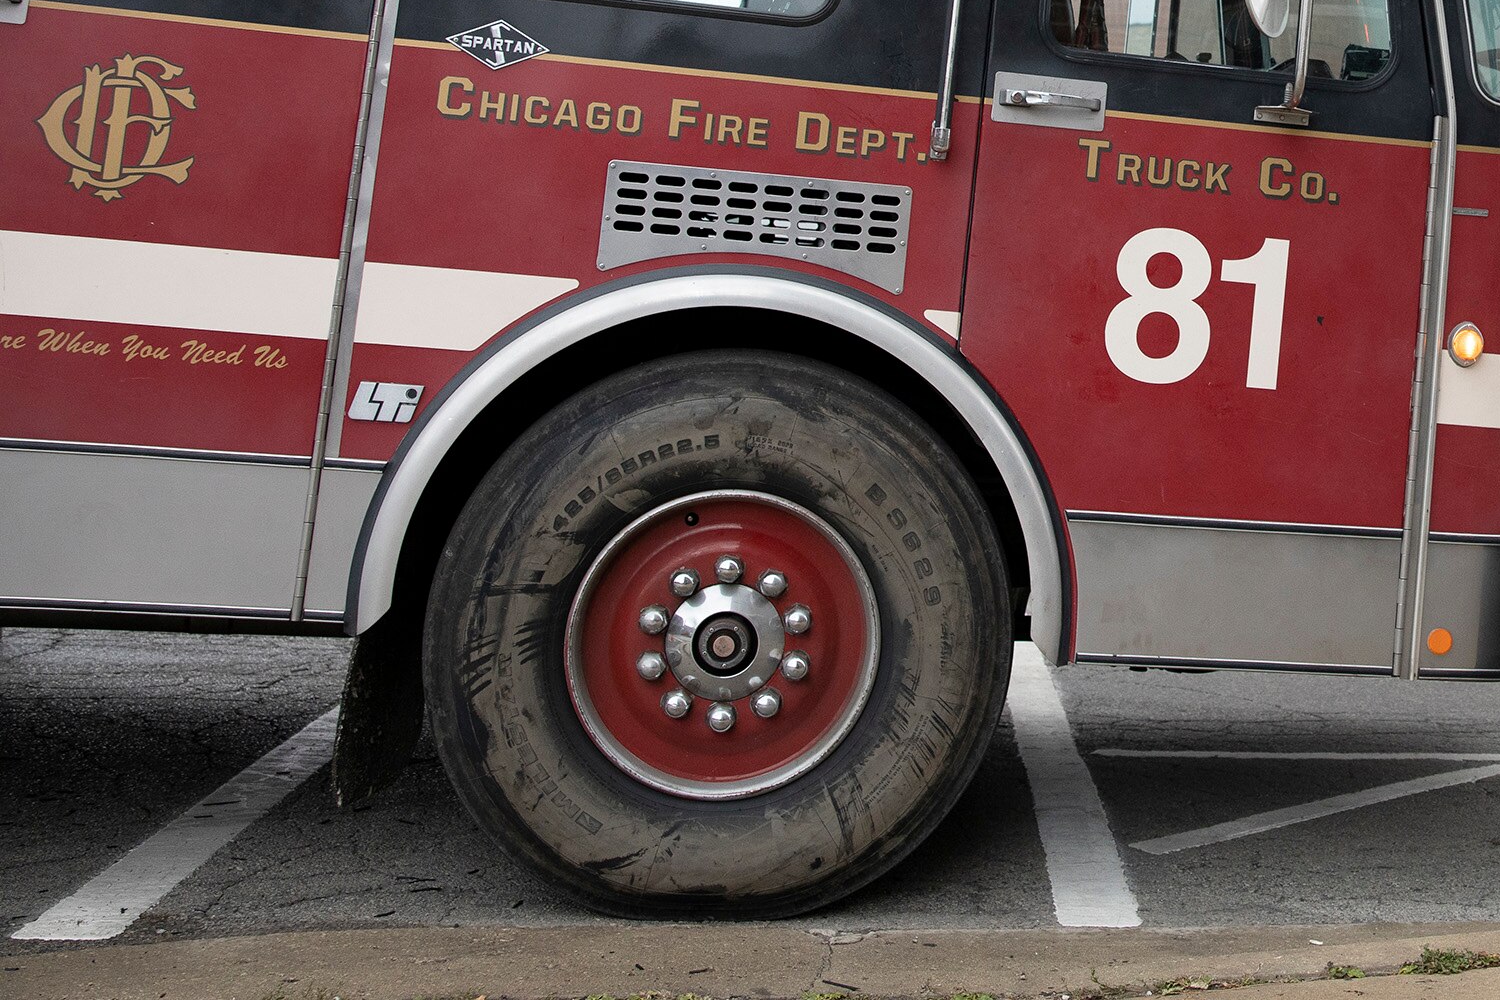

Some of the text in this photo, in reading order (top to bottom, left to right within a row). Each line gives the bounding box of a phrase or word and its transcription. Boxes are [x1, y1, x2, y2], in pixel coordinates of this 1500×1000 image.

[461, 34, 536, 55] SPARTAN
[436, 76, 644, 136] CHICAGO
[668, 98, 771, 149] FIRE
[1078, 138, 1232, 195] TRUCK
[1104, 227, 1291, 391] 81
[37, 328, 110, 356] When
[122, 334, 171, 362] You
[180, 339, 247, 365] Need
[253, 345, 289, 369] Us
[552, 434, 721, 532] 425/65R22.5
